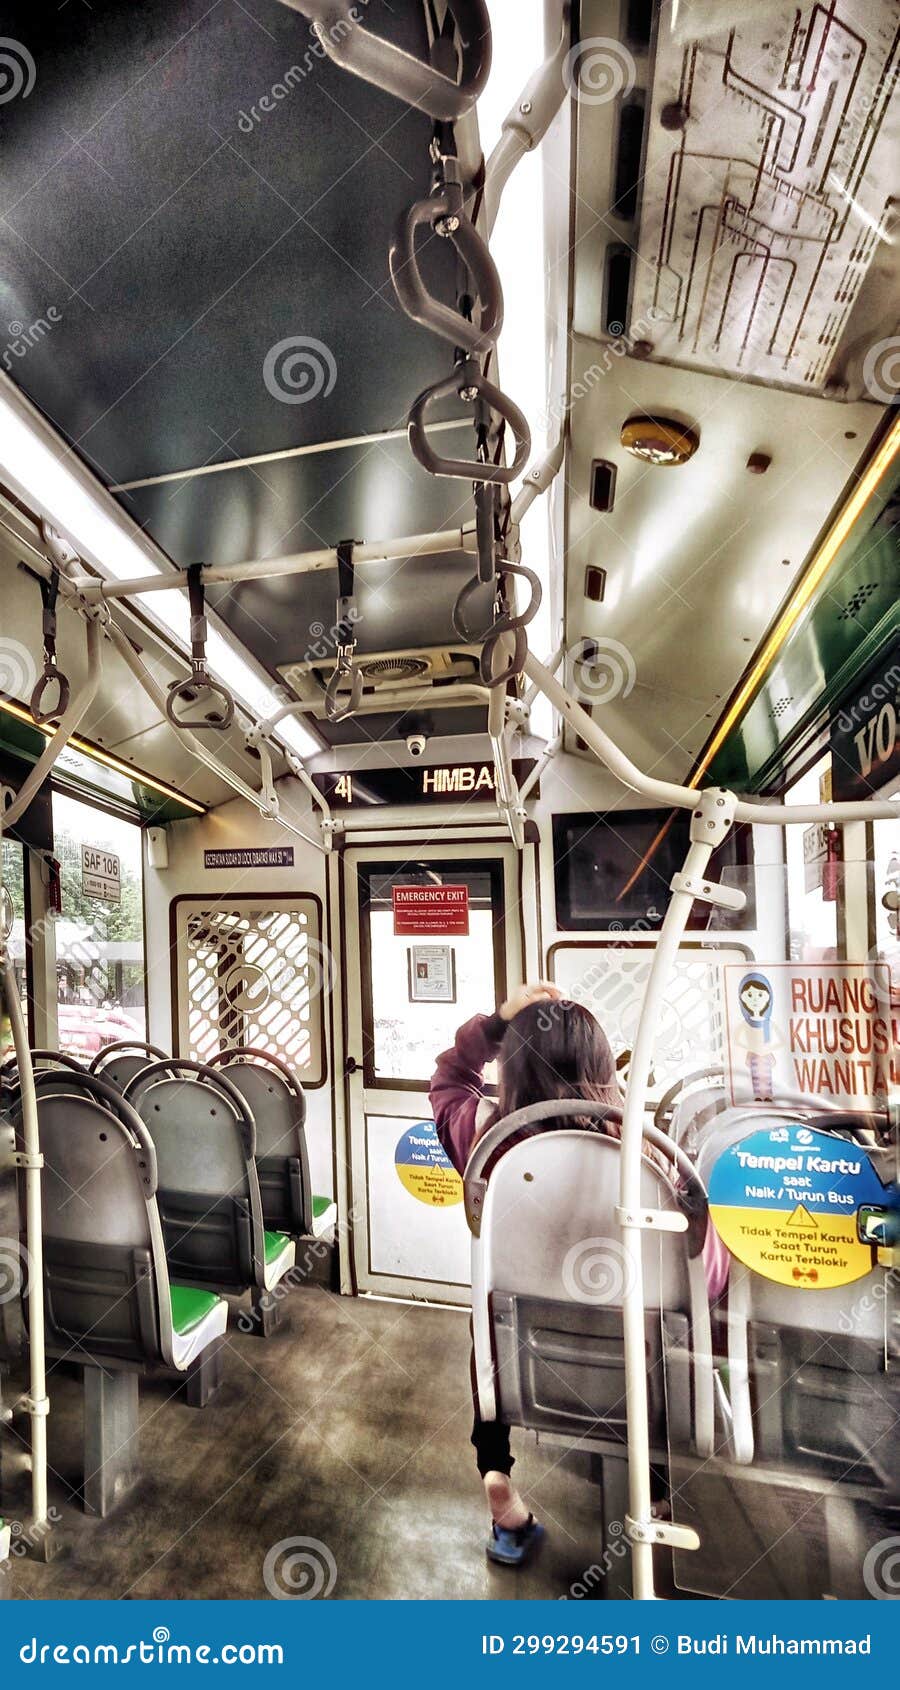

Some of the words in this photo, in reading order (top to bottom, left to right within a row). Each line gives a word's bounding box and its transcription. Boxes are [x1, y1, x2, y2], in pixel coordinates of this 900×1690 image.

[84, 850, 101, 870] SAF
[103, 856, 118, 876] 106
[396, 891, 445, 901] EMERGENCY
[447, 891, 464, 901] EXIT
[791, 977, 879, 1013] RUANG
[789, 1018, 889, 1054] KHUSUS
[793, 1058, 889, 1097] WANITA
[736, 1151, 803, 1173] Tempel
[807, 1155, 861, 1175] Kartu
[783, 1175, 812, 1187] saat
[745, 1185, 775, 1199] Naik
[786, 1189, 825, 1203] Turun
[828, 1190, 855, 1204] Bus
[740, 1225, 772, 1238] Tidak
[775, 1228, 817, 1242] Tempel
[821, 1232, 855, 1245] Kartu
[773, 1240, 800, 1252] Saat
[803, 1242, 838, 1255] Turun
[760, 1251, 793, 1263] Kartu
[795, 1254, 848, 1268] Terblokir
